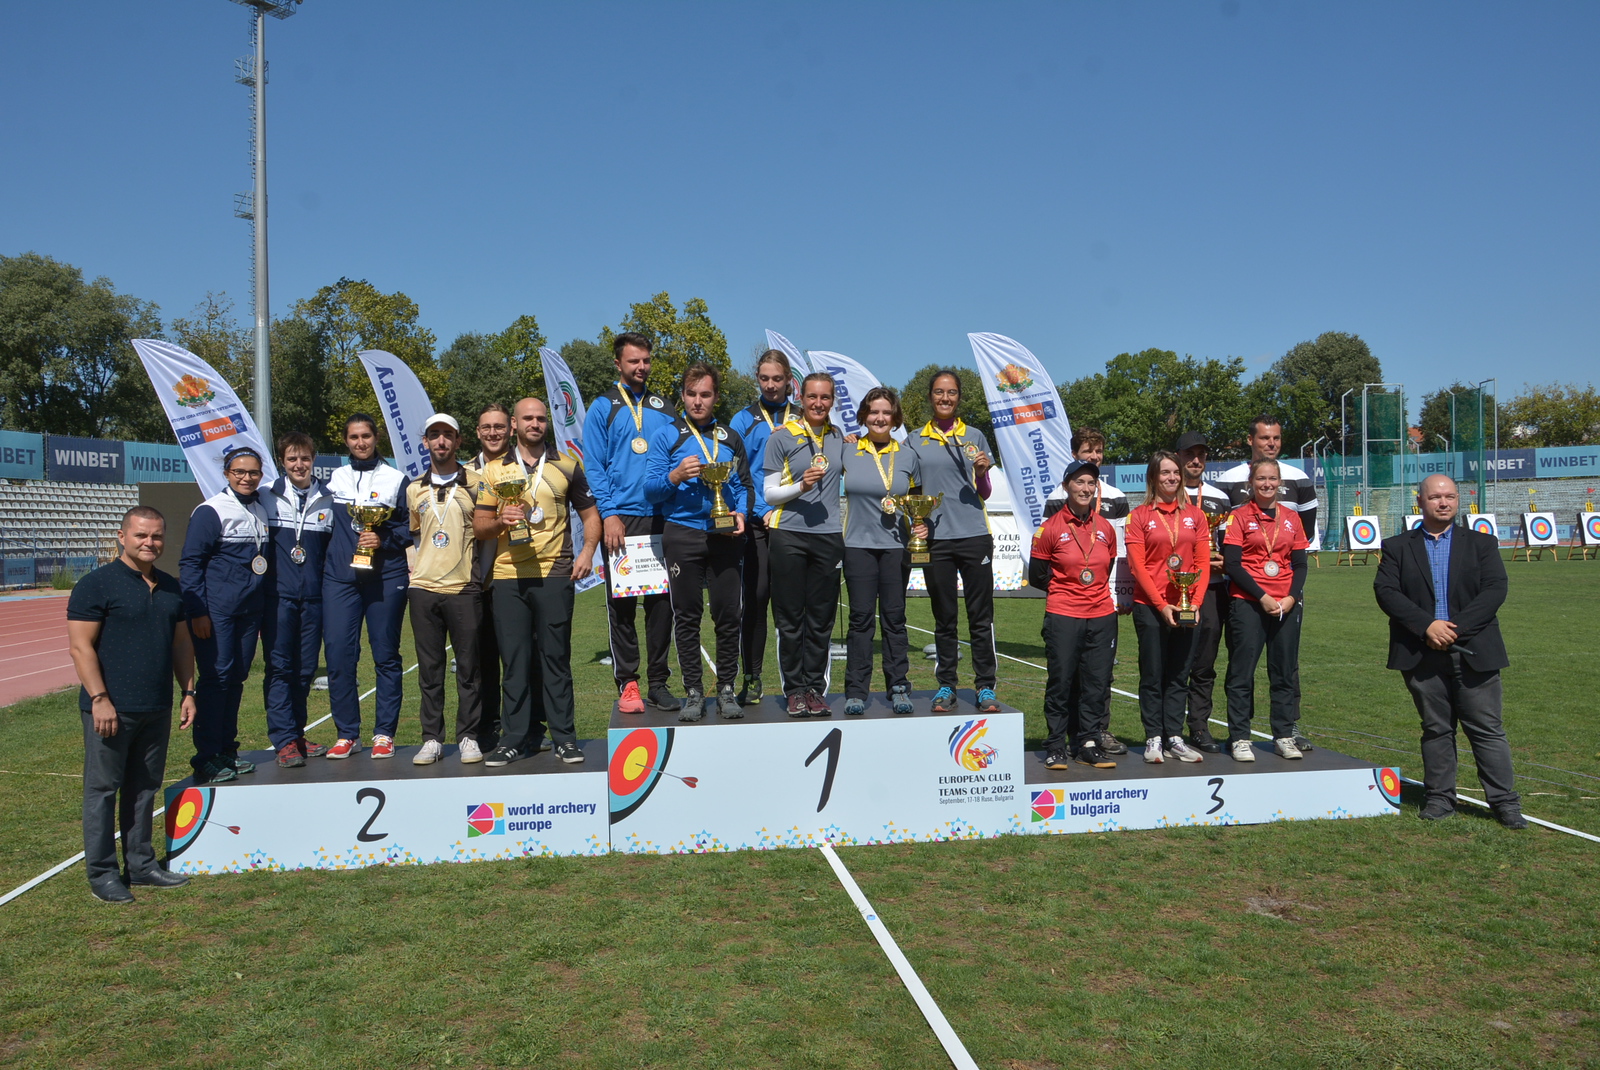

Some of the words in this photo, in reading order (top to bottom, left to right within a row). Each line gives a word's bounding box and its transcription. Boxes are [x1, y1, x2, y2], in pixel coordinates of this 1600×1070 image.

[826, 366, 862, 437] rchery
[375, 366, 412, 455] archery
[55, 449, 119, 468] WINBET
[131, 455, 188, 473] WINBET
[1540, 455, 1597, 468] WINBET
[804, 727, 842, 813] 1
[939, 774, 986, 784] EUROPEAN
[988, 773, 1011, 782] CLUB
[939, 787, 968, 796] TEAMS
[970, 786, 988, 795] CUP
[991, 785, 1014, 794] 2022
[1069, 788, 1102, 801] world
[1105, 788, 1148, 800] archery
[1206, 777, 1224, 815] 3
[939, 797, 966, 805] September,
[356, 787, 388, 842] 2
[508, 803, 544, 816] world
[548, 802, 596, 815] archery
[1070, 802, 1120, 817] bulgaria
[508, 820, 552, 832] europe
